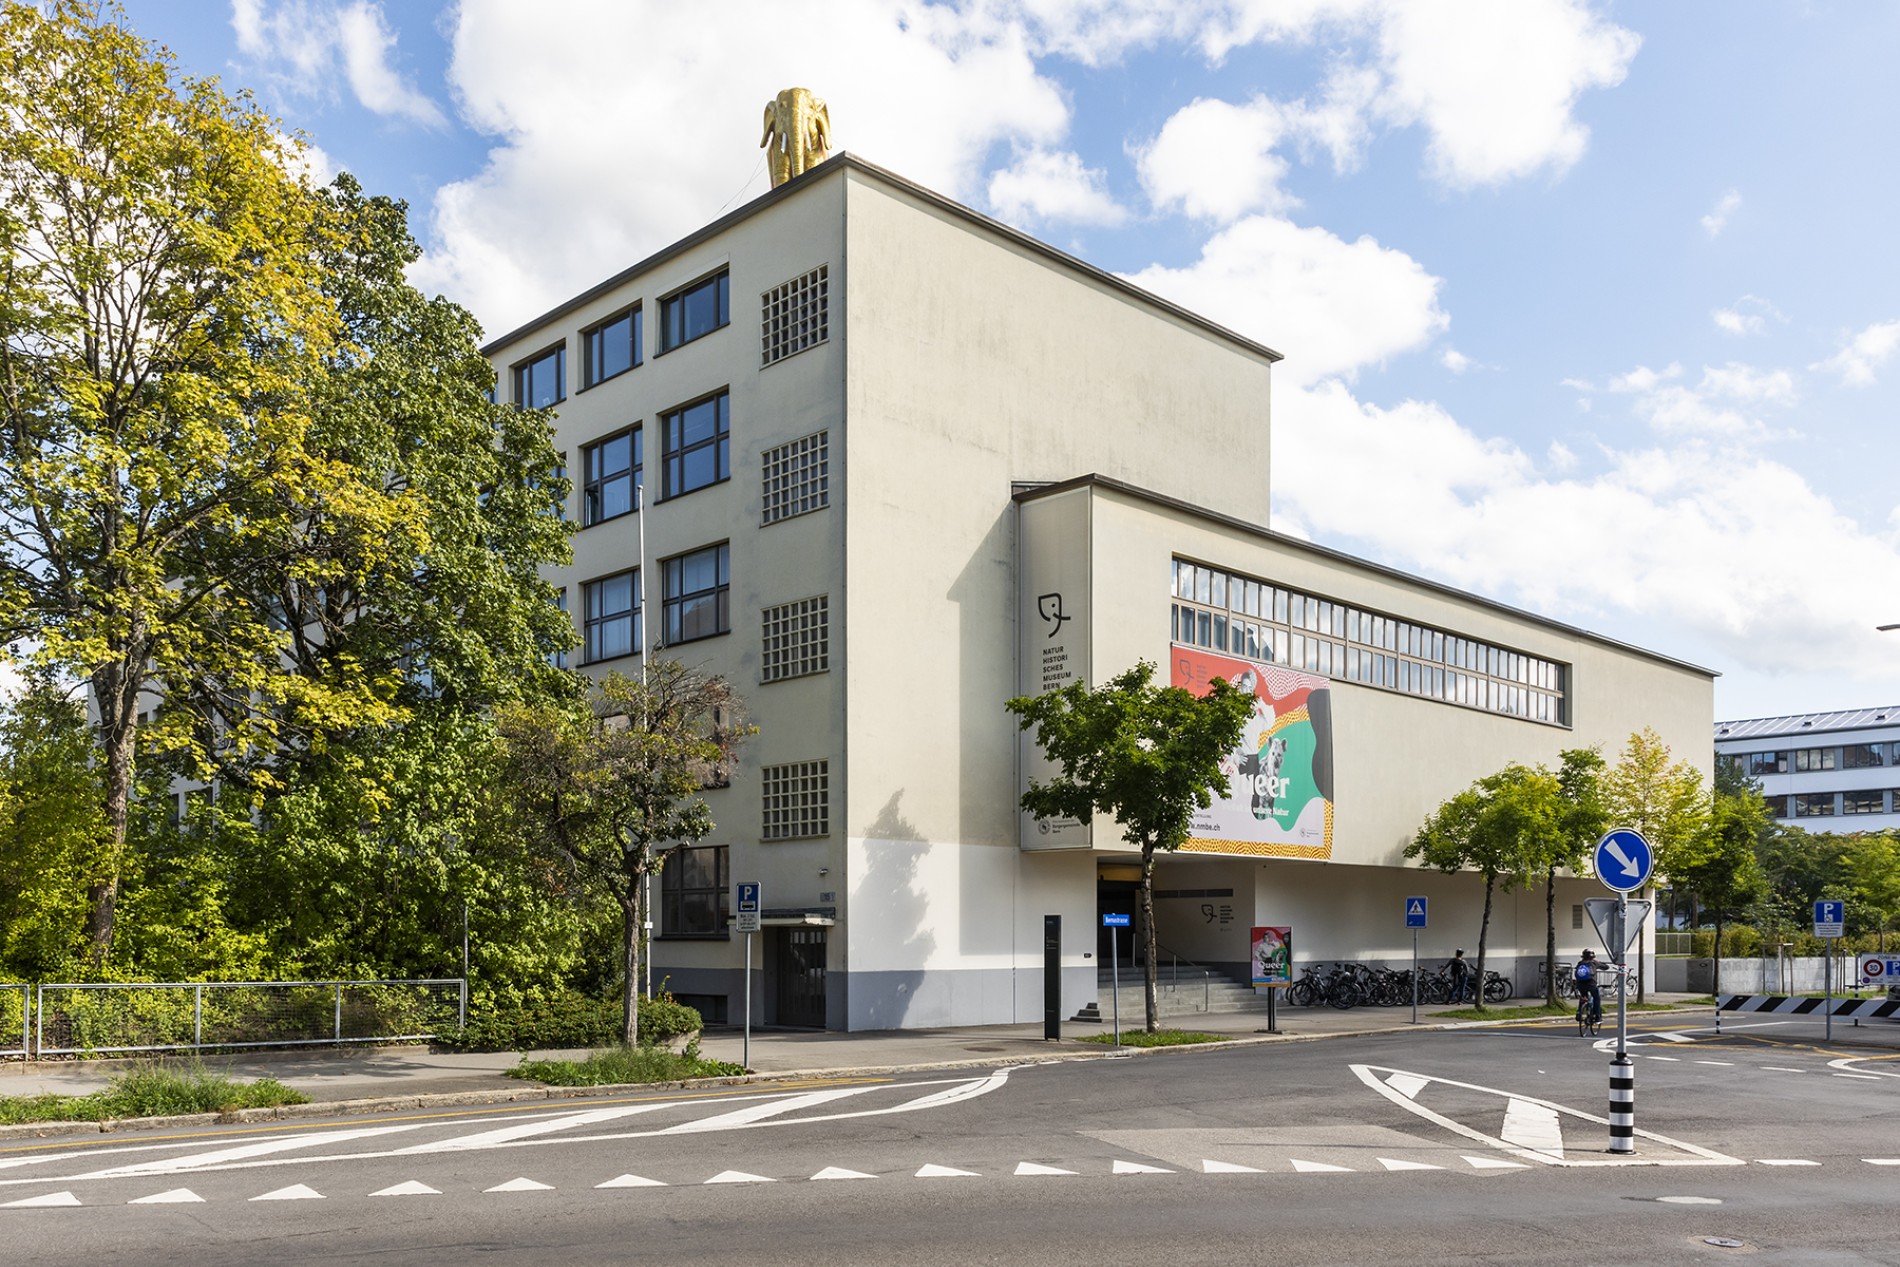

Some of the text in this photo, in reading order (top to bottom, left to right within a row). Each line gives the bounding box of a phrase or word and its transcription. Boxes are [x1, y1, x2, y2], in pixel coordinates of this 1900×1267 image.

[1043, 646, 1064, 655] NATUR
[1043, 655, 1068, 664] HISTORI
[1043, 664, 1063, 673] SCHES
[1043, 672, 1071, 681] MUSEUM
[1043, 682, 1060, 690] BERN
[744, 886, 752, 900] P
[1824, 903, 1834, 914] P
[1257, 961, 1285, 970] Queer
